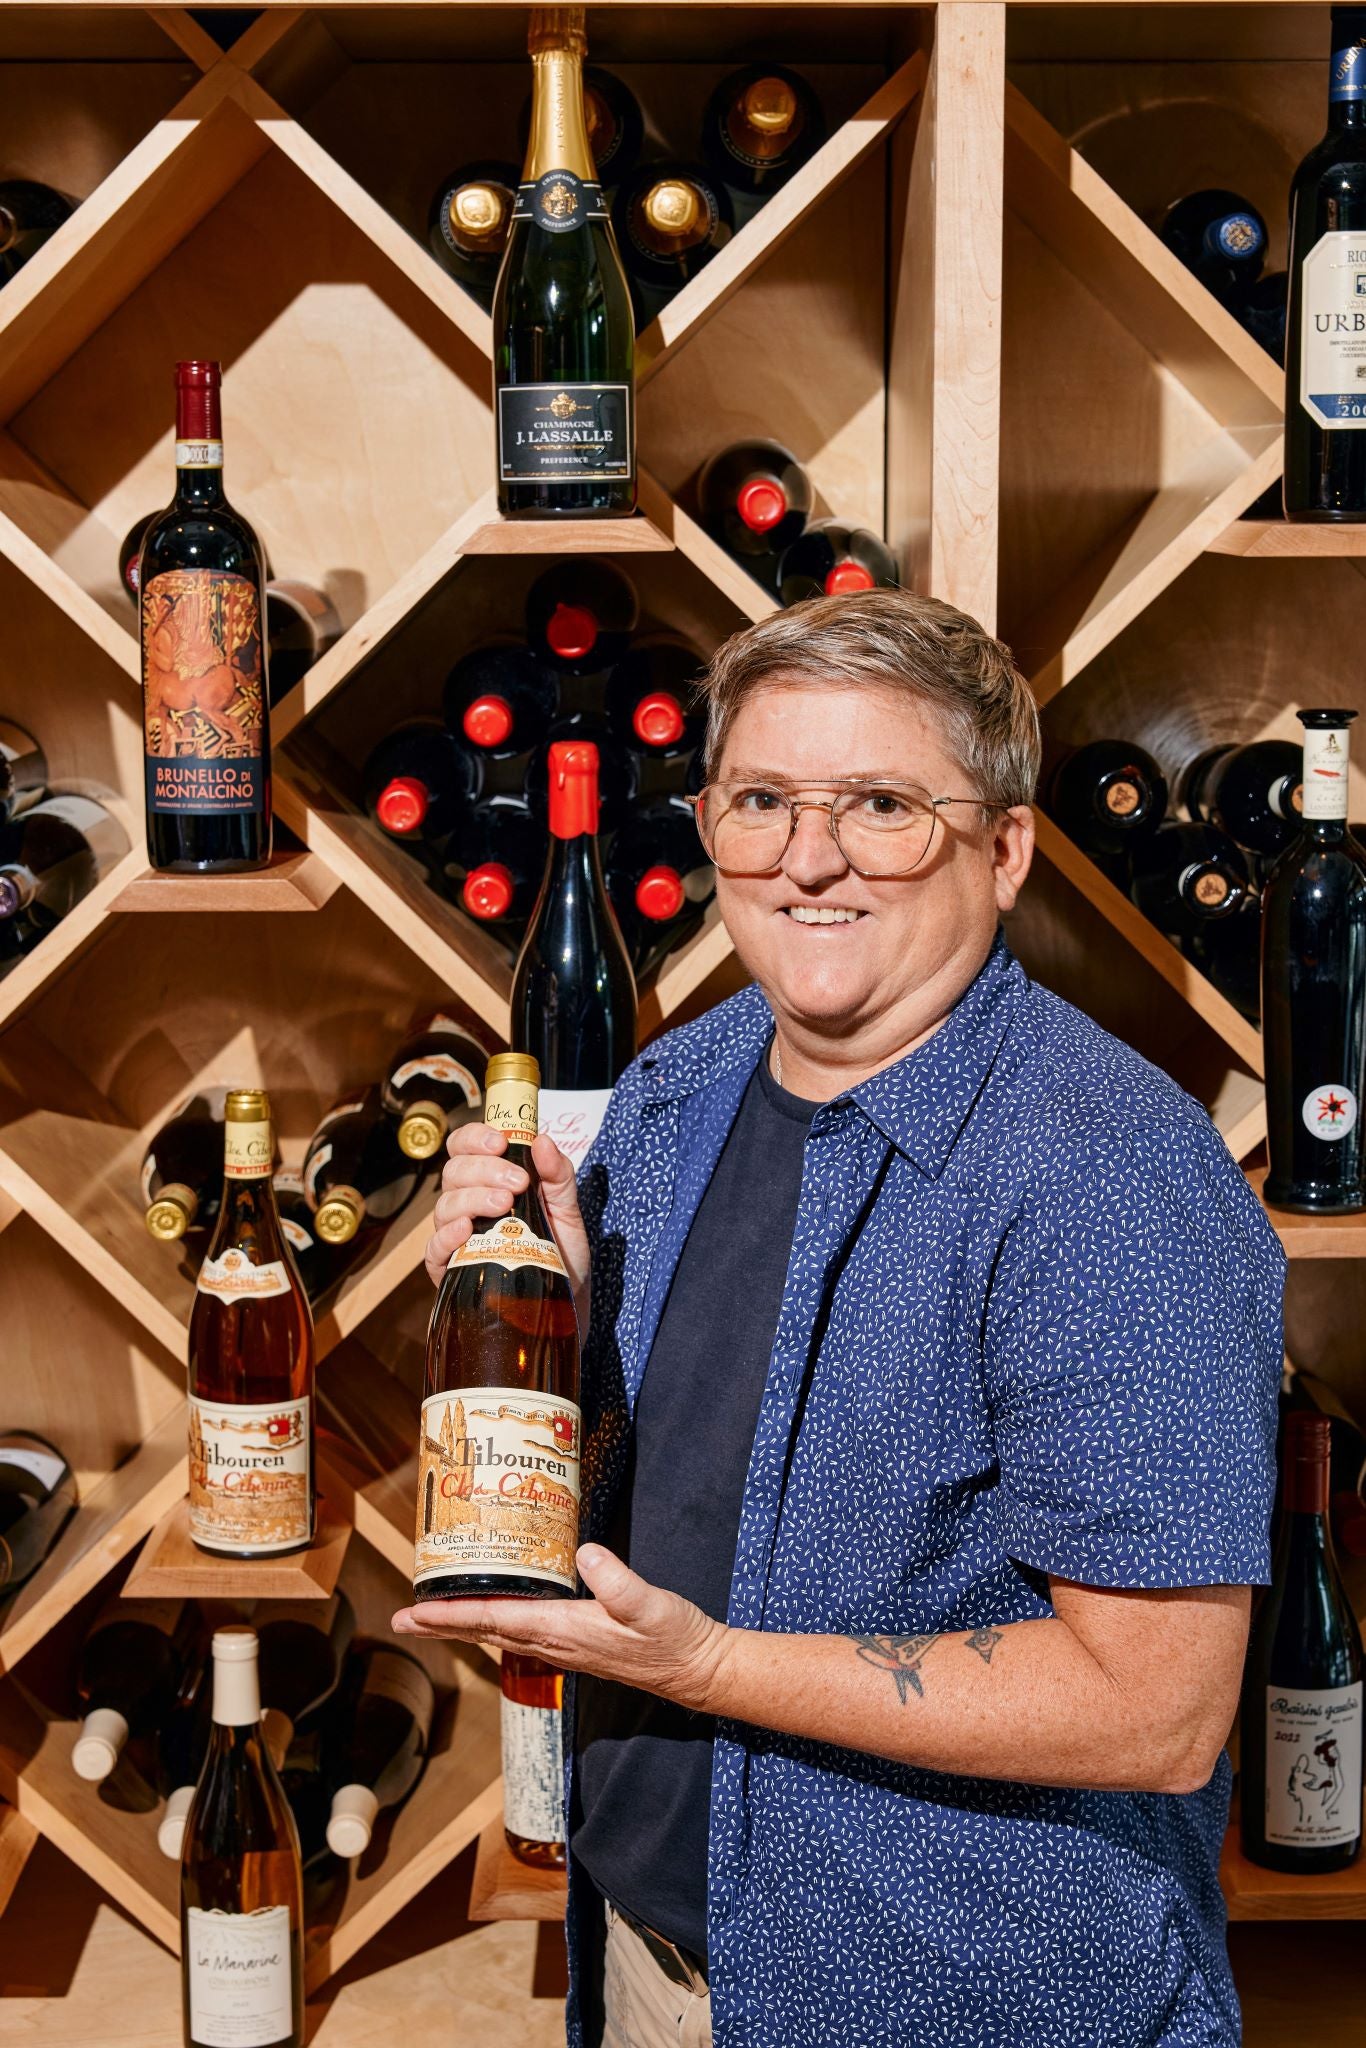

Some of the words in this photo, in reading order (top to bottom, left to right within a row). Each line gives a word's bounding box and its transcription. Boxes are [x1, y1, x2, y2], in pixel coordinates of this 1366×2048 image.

[542, 174, 577, 186] CHAMPAGNE
[533, 421, 594, 429] CHAMPAGNE
[516, 432, 525, 445] J.
[528, 430, 613, 443] LASSALLE
[156, 767, 237, 783] BRUNELLO
[240, 771, 251, 782] DI
[155, 783, 254, 799] MONTALCINO
[486, 1104, 513, 1122] Clos
[499, 1225, 525, 1235] 2021
[479, 1246, 500, 1254] CRU
[511, 1239, 558, 1255] PROVENCE
[198, 1437, 285, 1468] Tibouren
[456, 1437, 567, 1477] Tibouren
[223, 1472, 290, 1493] Cibonne
[440, 1471, 489, 1499] Clos
[498, 1472, 571, 1510] Cibonne
[433, 1531, 464, 1546] Côtes
[468, 1529, 484, 1543] de
[489, 1529, 547, 1548] Provence
[461, 1551, 481, 1559] CRU
[1270, 1698, 1322, 1716] Raisins
[1275, 1731, 1301, 1743] 2022
